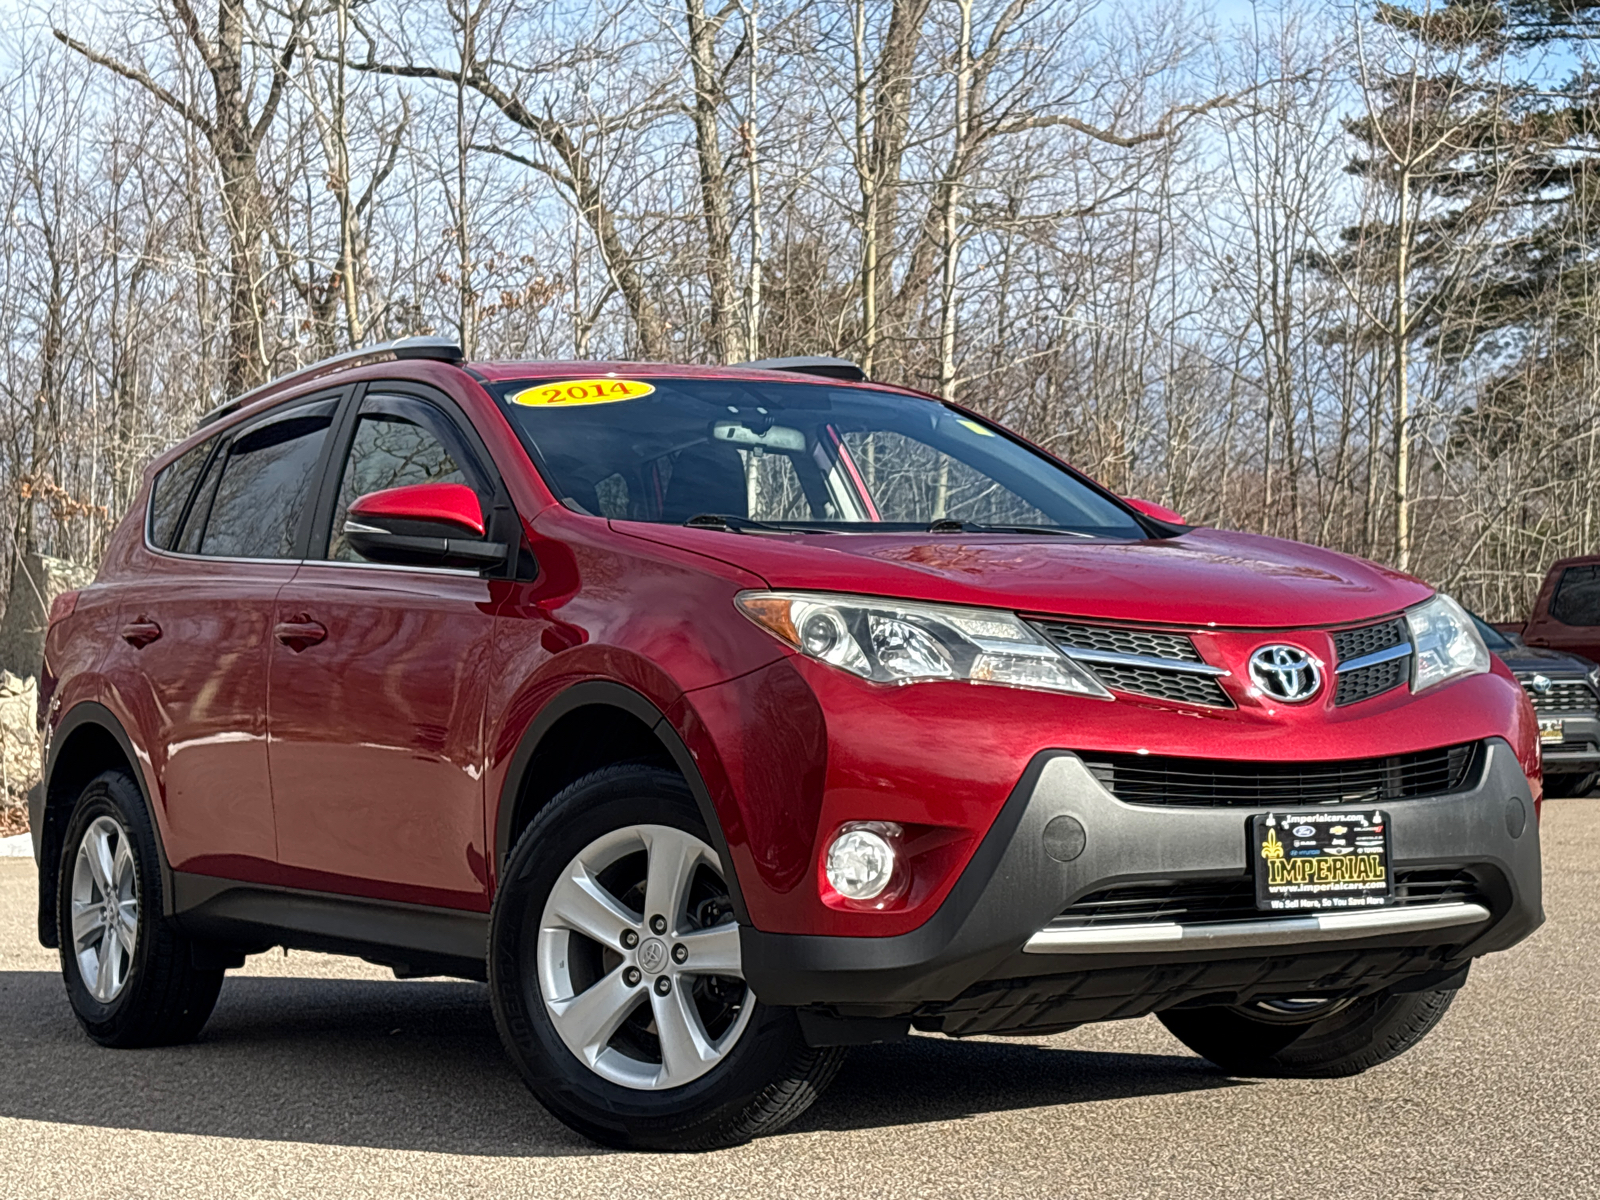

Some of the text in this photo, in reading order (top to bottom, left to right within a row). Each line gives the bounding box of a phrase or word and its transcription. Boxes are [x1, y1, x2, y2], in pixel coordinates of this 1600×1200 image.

[541, 382, 633, 403] 2014
[1286, 813, 1365, 824] Imperialcars.com
[1268, 855, 1385, 884] IMPERIAL
[1269, 881, 1386, 893] www.imperialcars.com
[1271, 900, 1284, 909] We
[1285, 899, 1299, 908] Sell
[1322, 898, 1332, 906] So
[1333, 898, 1347, 906] You
[1348, 897, 1365, 906] Save
[1366, 896, 1384, 905] More
